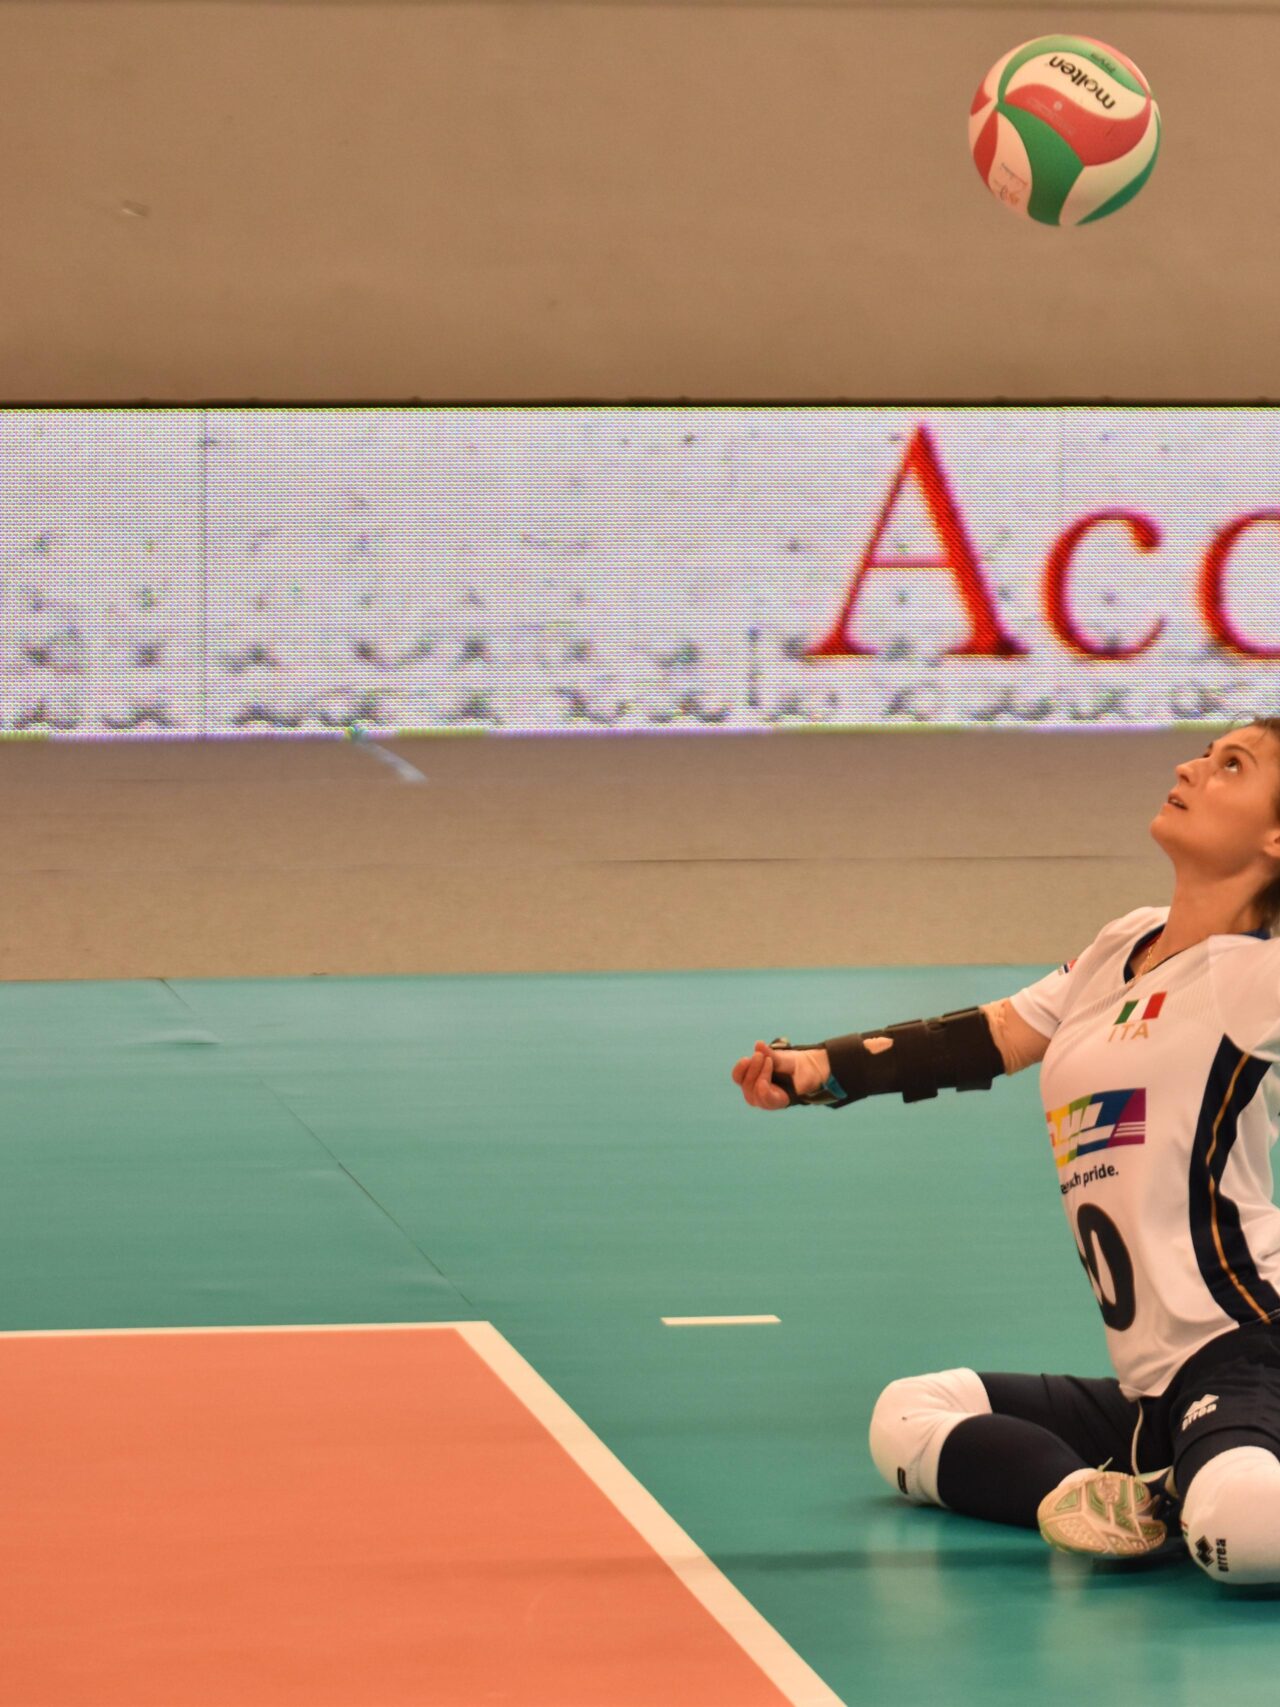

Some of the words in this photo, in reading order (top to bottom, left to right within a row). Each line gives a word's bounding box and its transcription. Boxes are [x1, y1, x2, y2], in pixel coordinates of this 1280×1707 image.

[1048, 55, 1116, 110] molten
[1107, 1021, 1149, 1042] ITA
[1083, 1163, 1119, 1188] pride.
